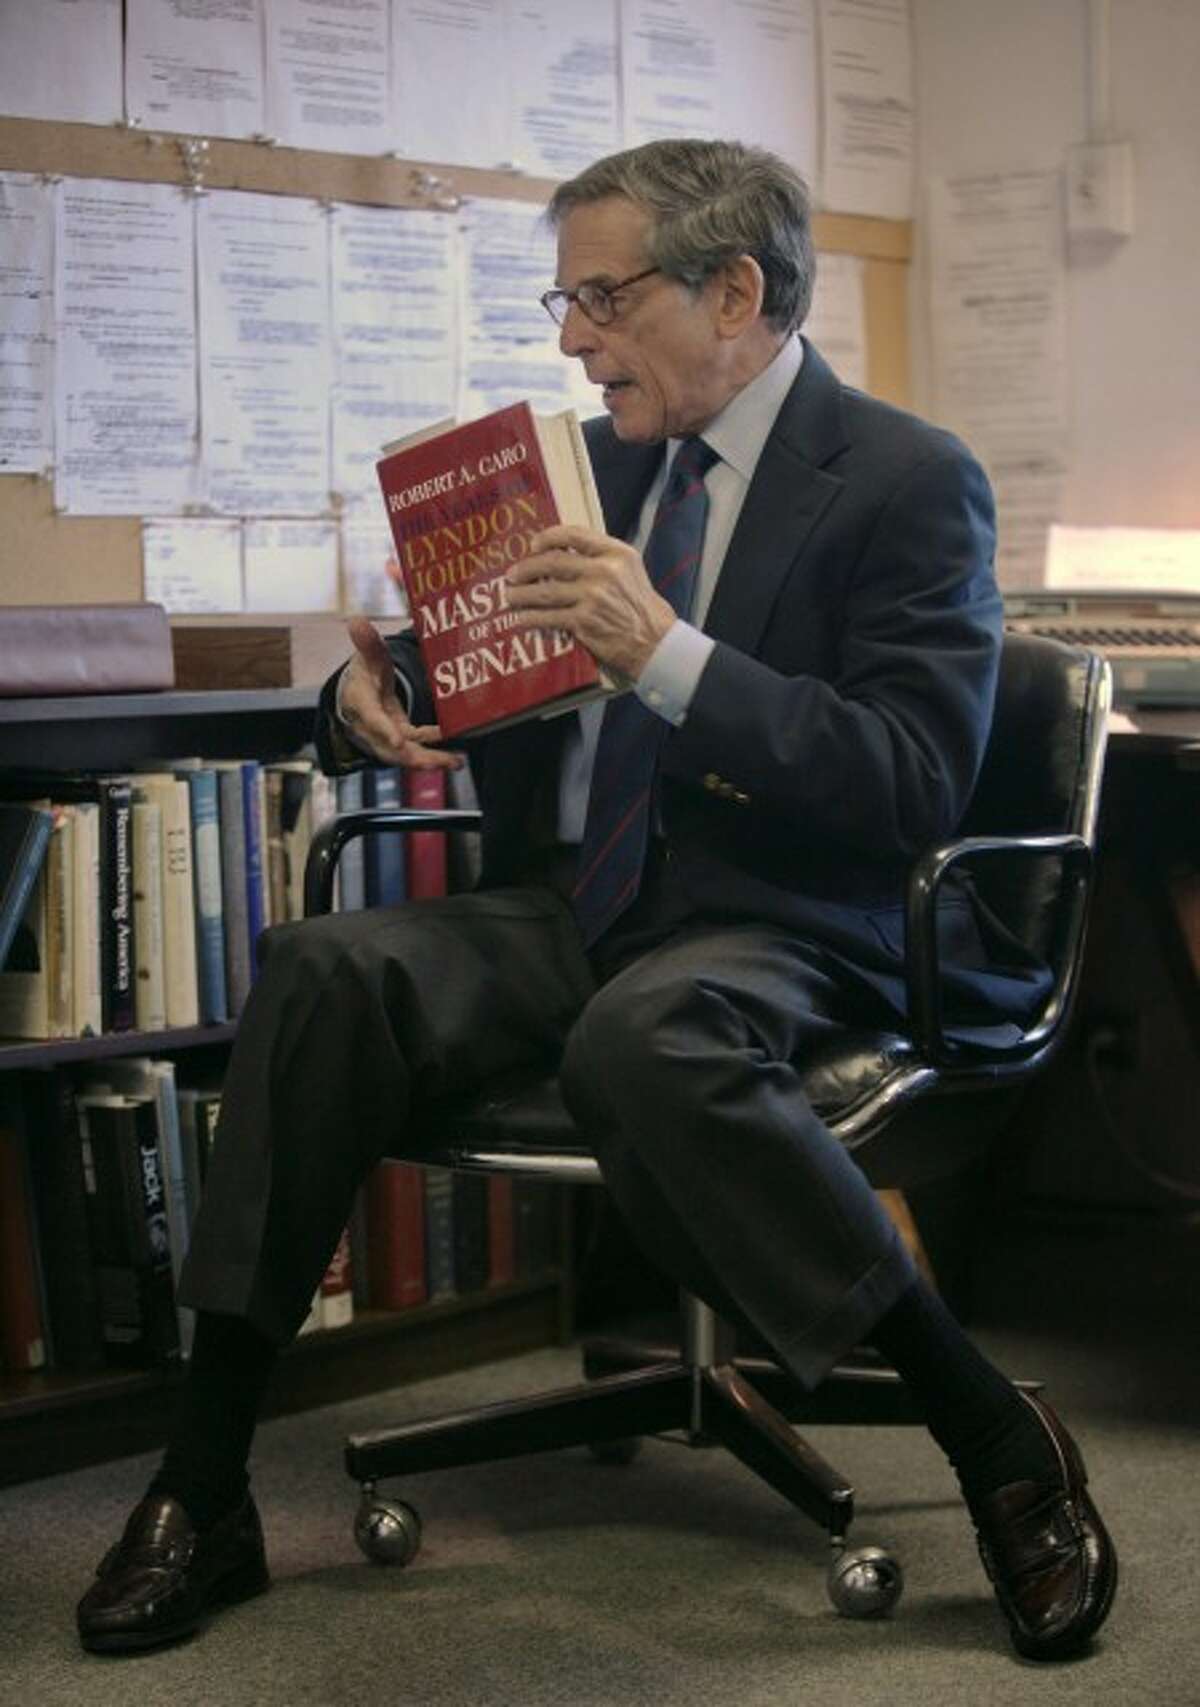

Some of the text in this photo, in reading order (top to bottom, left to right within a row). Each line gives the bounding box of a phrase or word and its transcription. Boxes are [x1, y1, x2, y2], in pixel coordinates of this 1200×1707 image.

[388, 443, 528, 513] ROBERT A. CARO
[405, 494, 538, 569] LYNDON
[419, 575, 511, 639] MAST
[468, 621, 489, 641] OF
[433, 628, 575, 699] SENATE
[112, 808, 130, 921] Remembering
[116, 922, 130, 991] America
